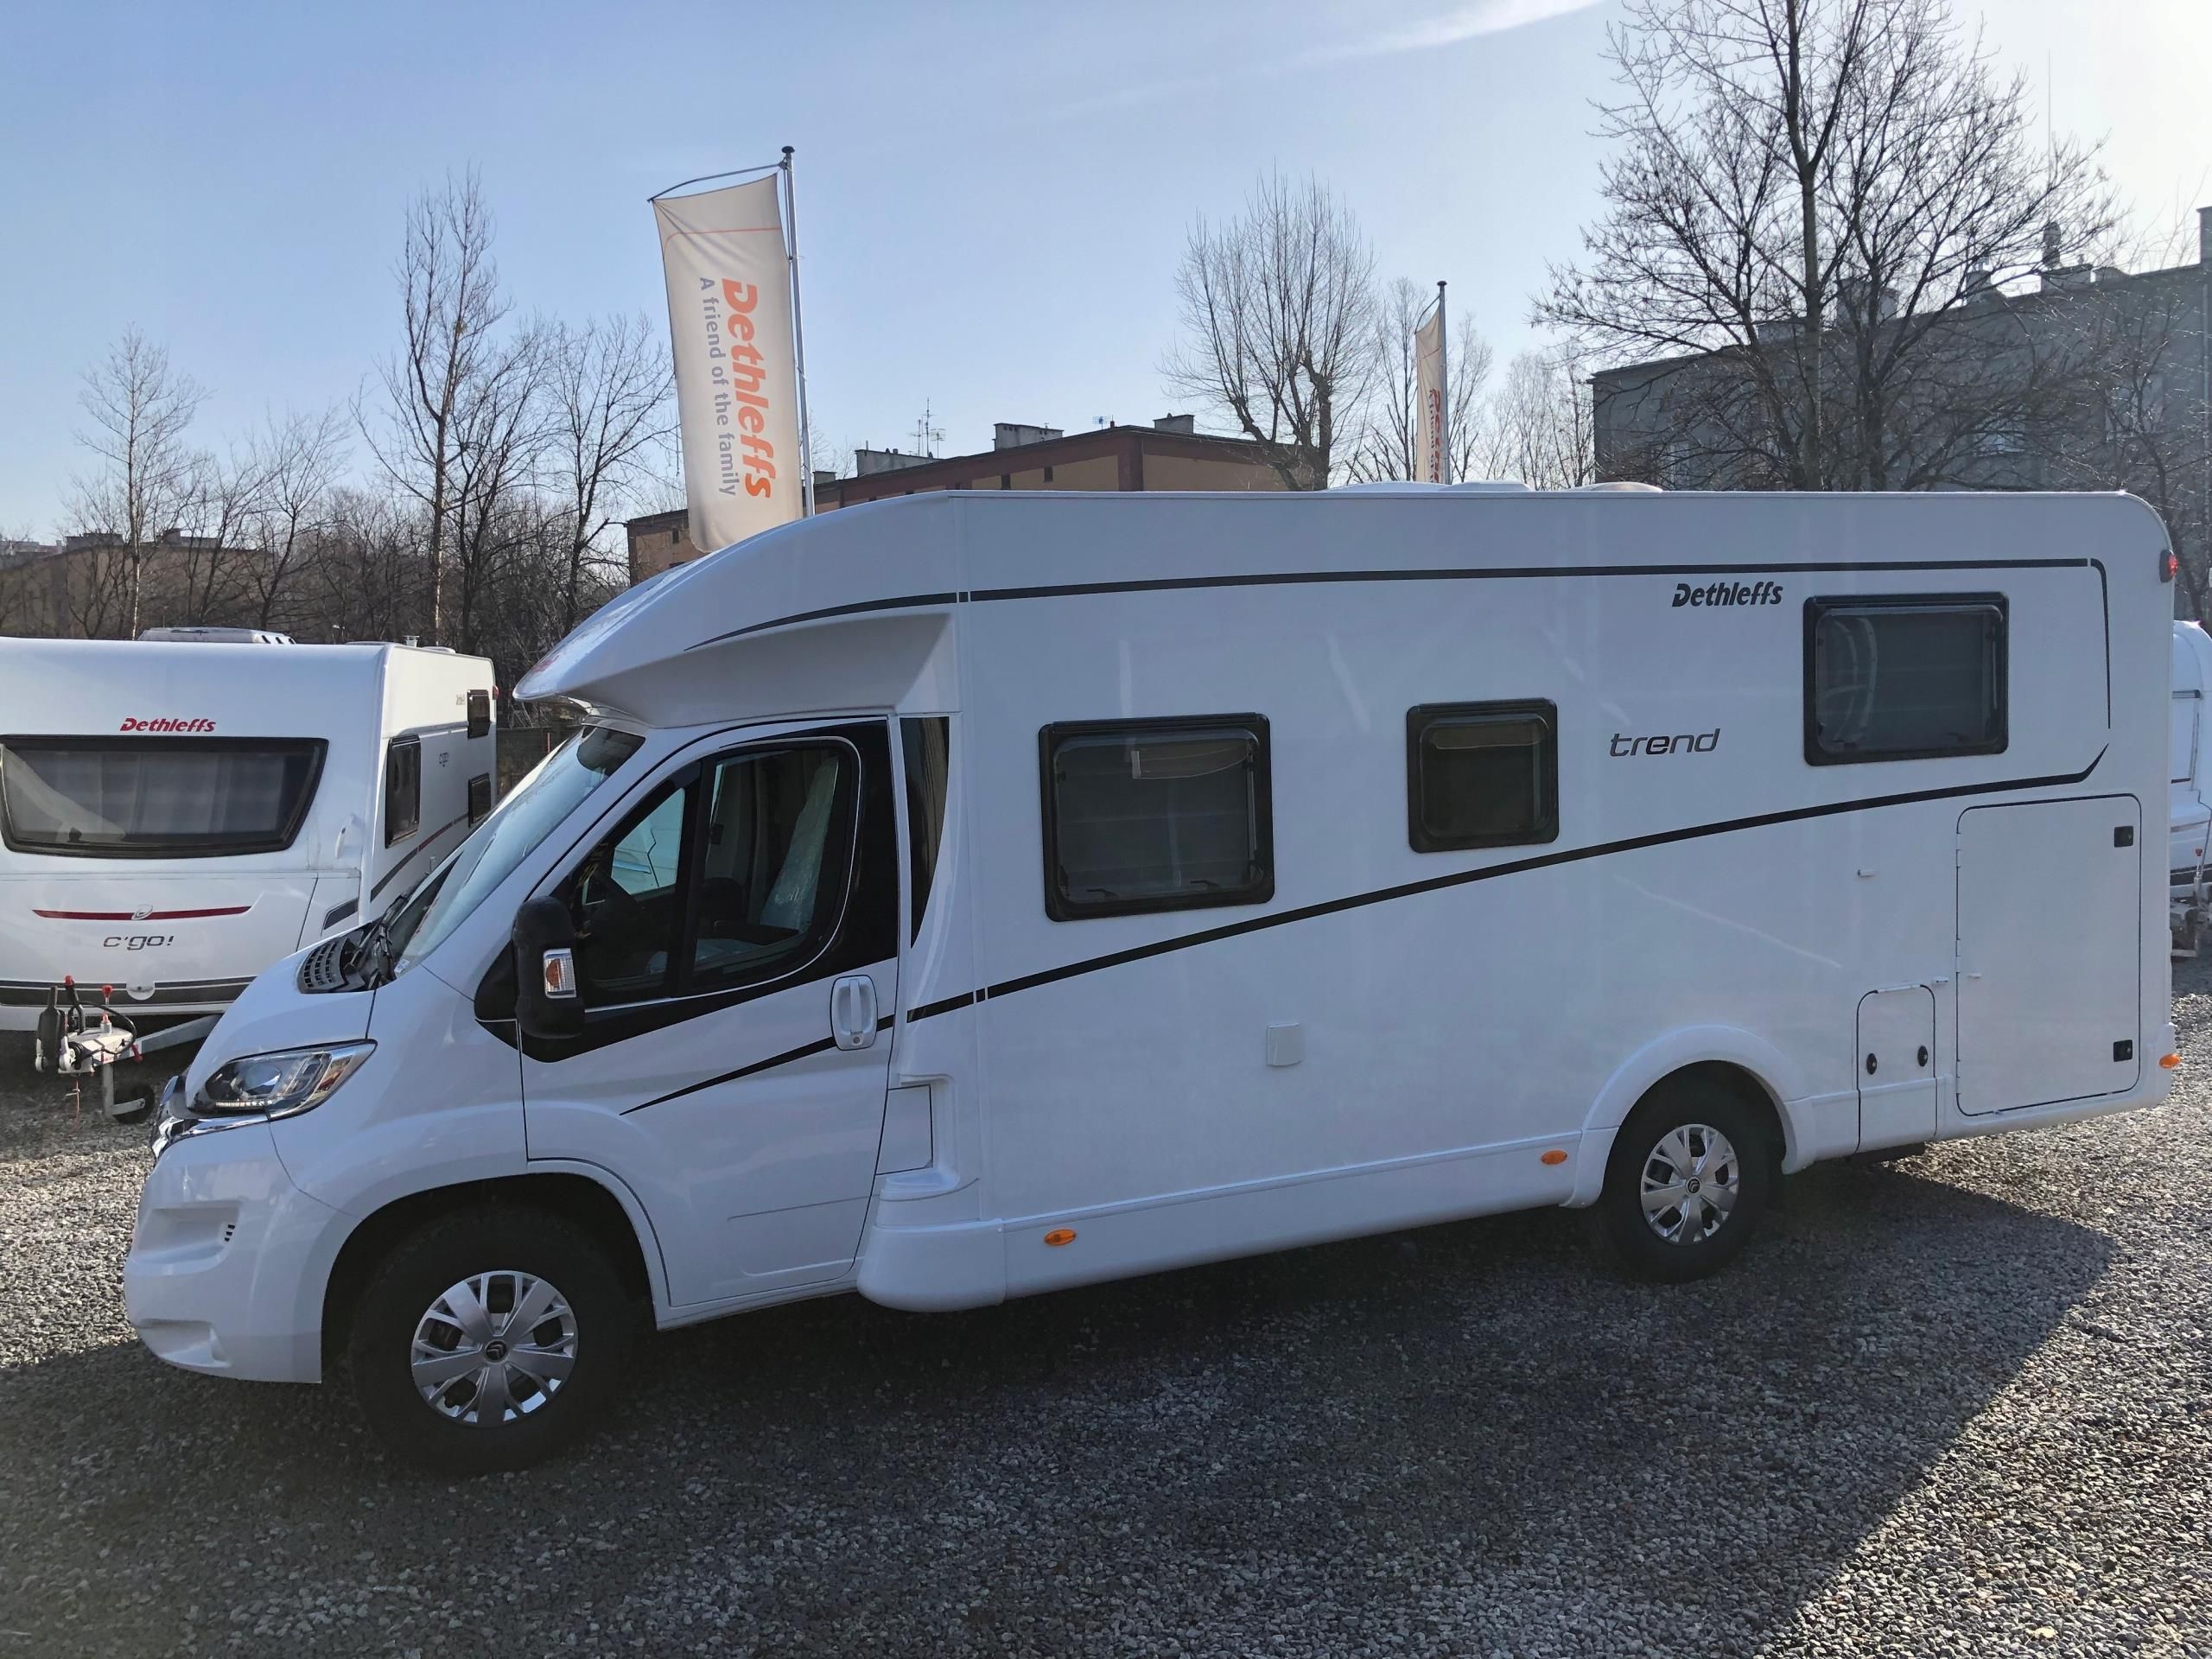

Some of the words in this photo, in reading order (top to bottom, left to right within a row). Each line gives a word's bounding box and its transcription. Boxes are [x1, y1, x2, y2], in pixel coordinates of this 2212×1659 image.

[700, 277, 715, 290] A
[702, 296, 727, 359] friend
[711, 365, 729, 385] of
[721, 277, 776, 499] Dethleffs
[715, 392, 732, 426] the
[718, 433, 741, 497] family
[1671, 581, 1784, 607] Dethleffs
[119, 717, 217, 733] Dethleffs
[1610, 728, 1721, 757] trend
[103, 935, 175, 950] c'go!
